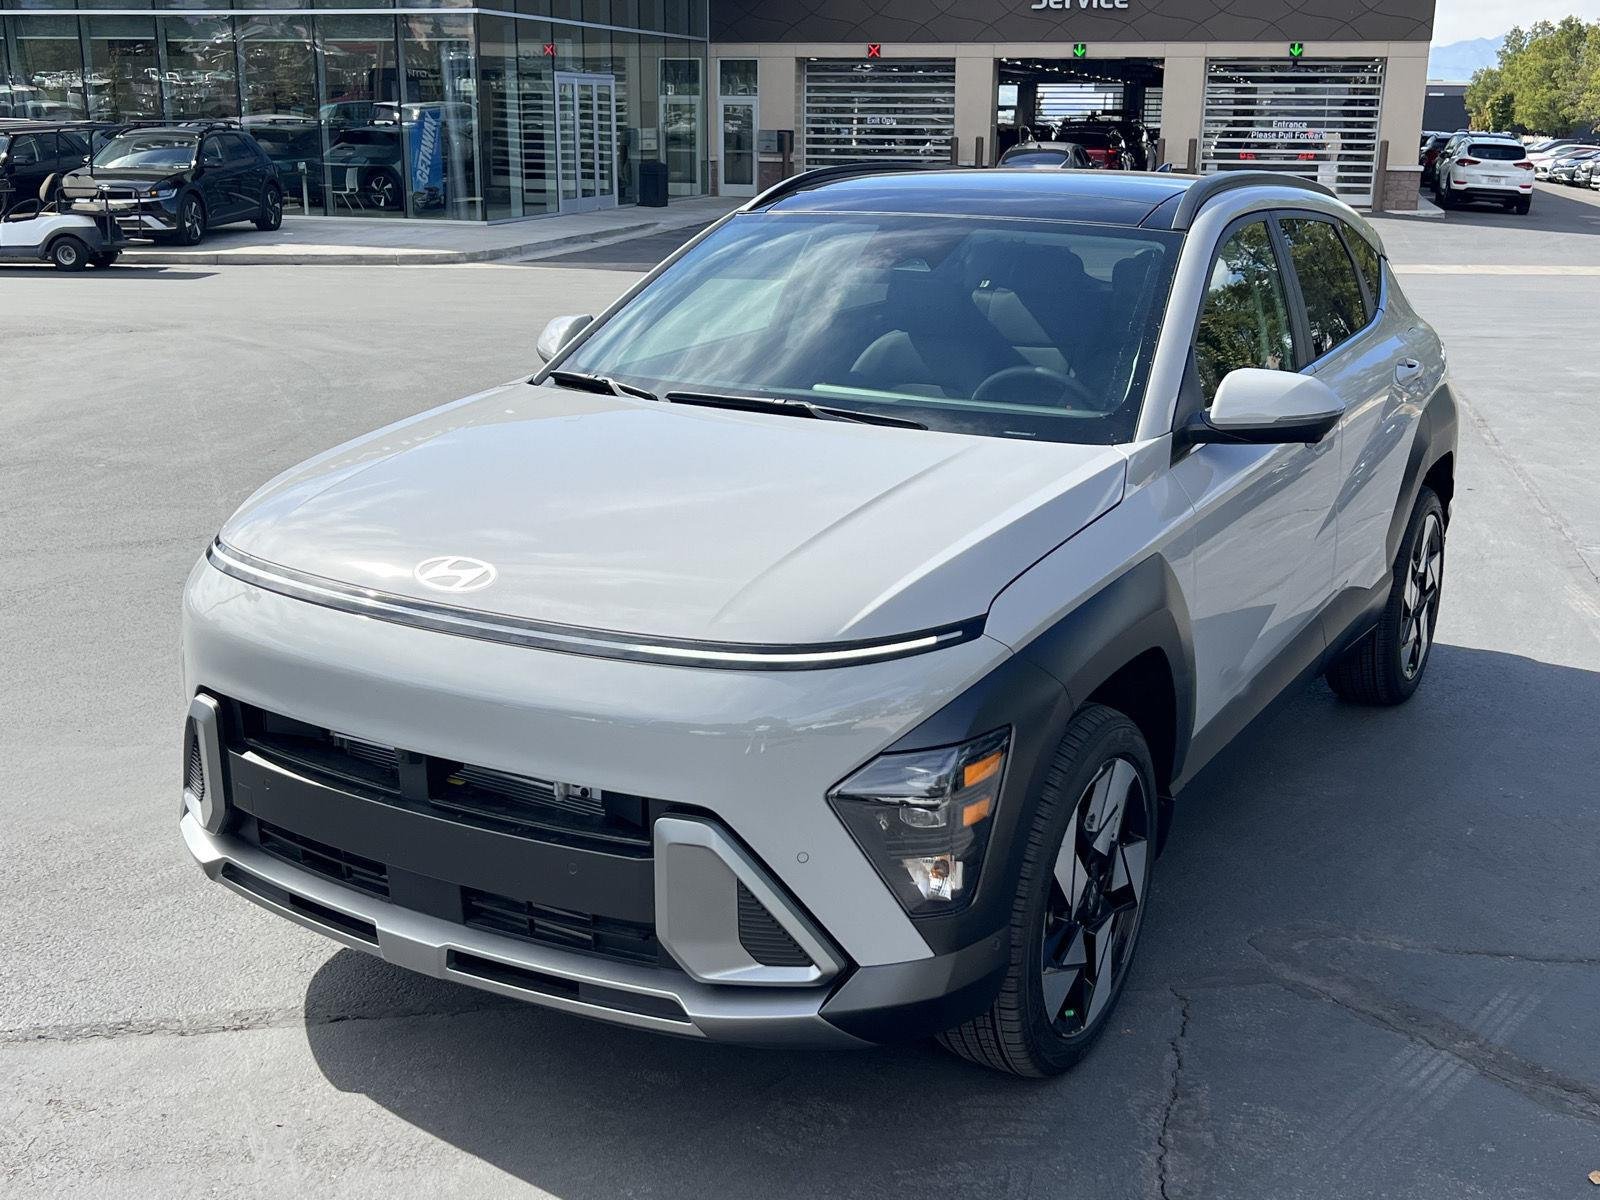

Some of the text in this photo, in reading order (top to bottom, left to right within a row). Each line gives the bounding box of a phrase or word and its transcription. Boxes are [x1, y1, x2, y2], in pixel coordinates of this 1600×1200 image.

[1272, 120, 1308, 129] Entrance
[1250, 131, 1328, 140] Please Pull Forward
[416, 111, 438, 184] GETAWAY
